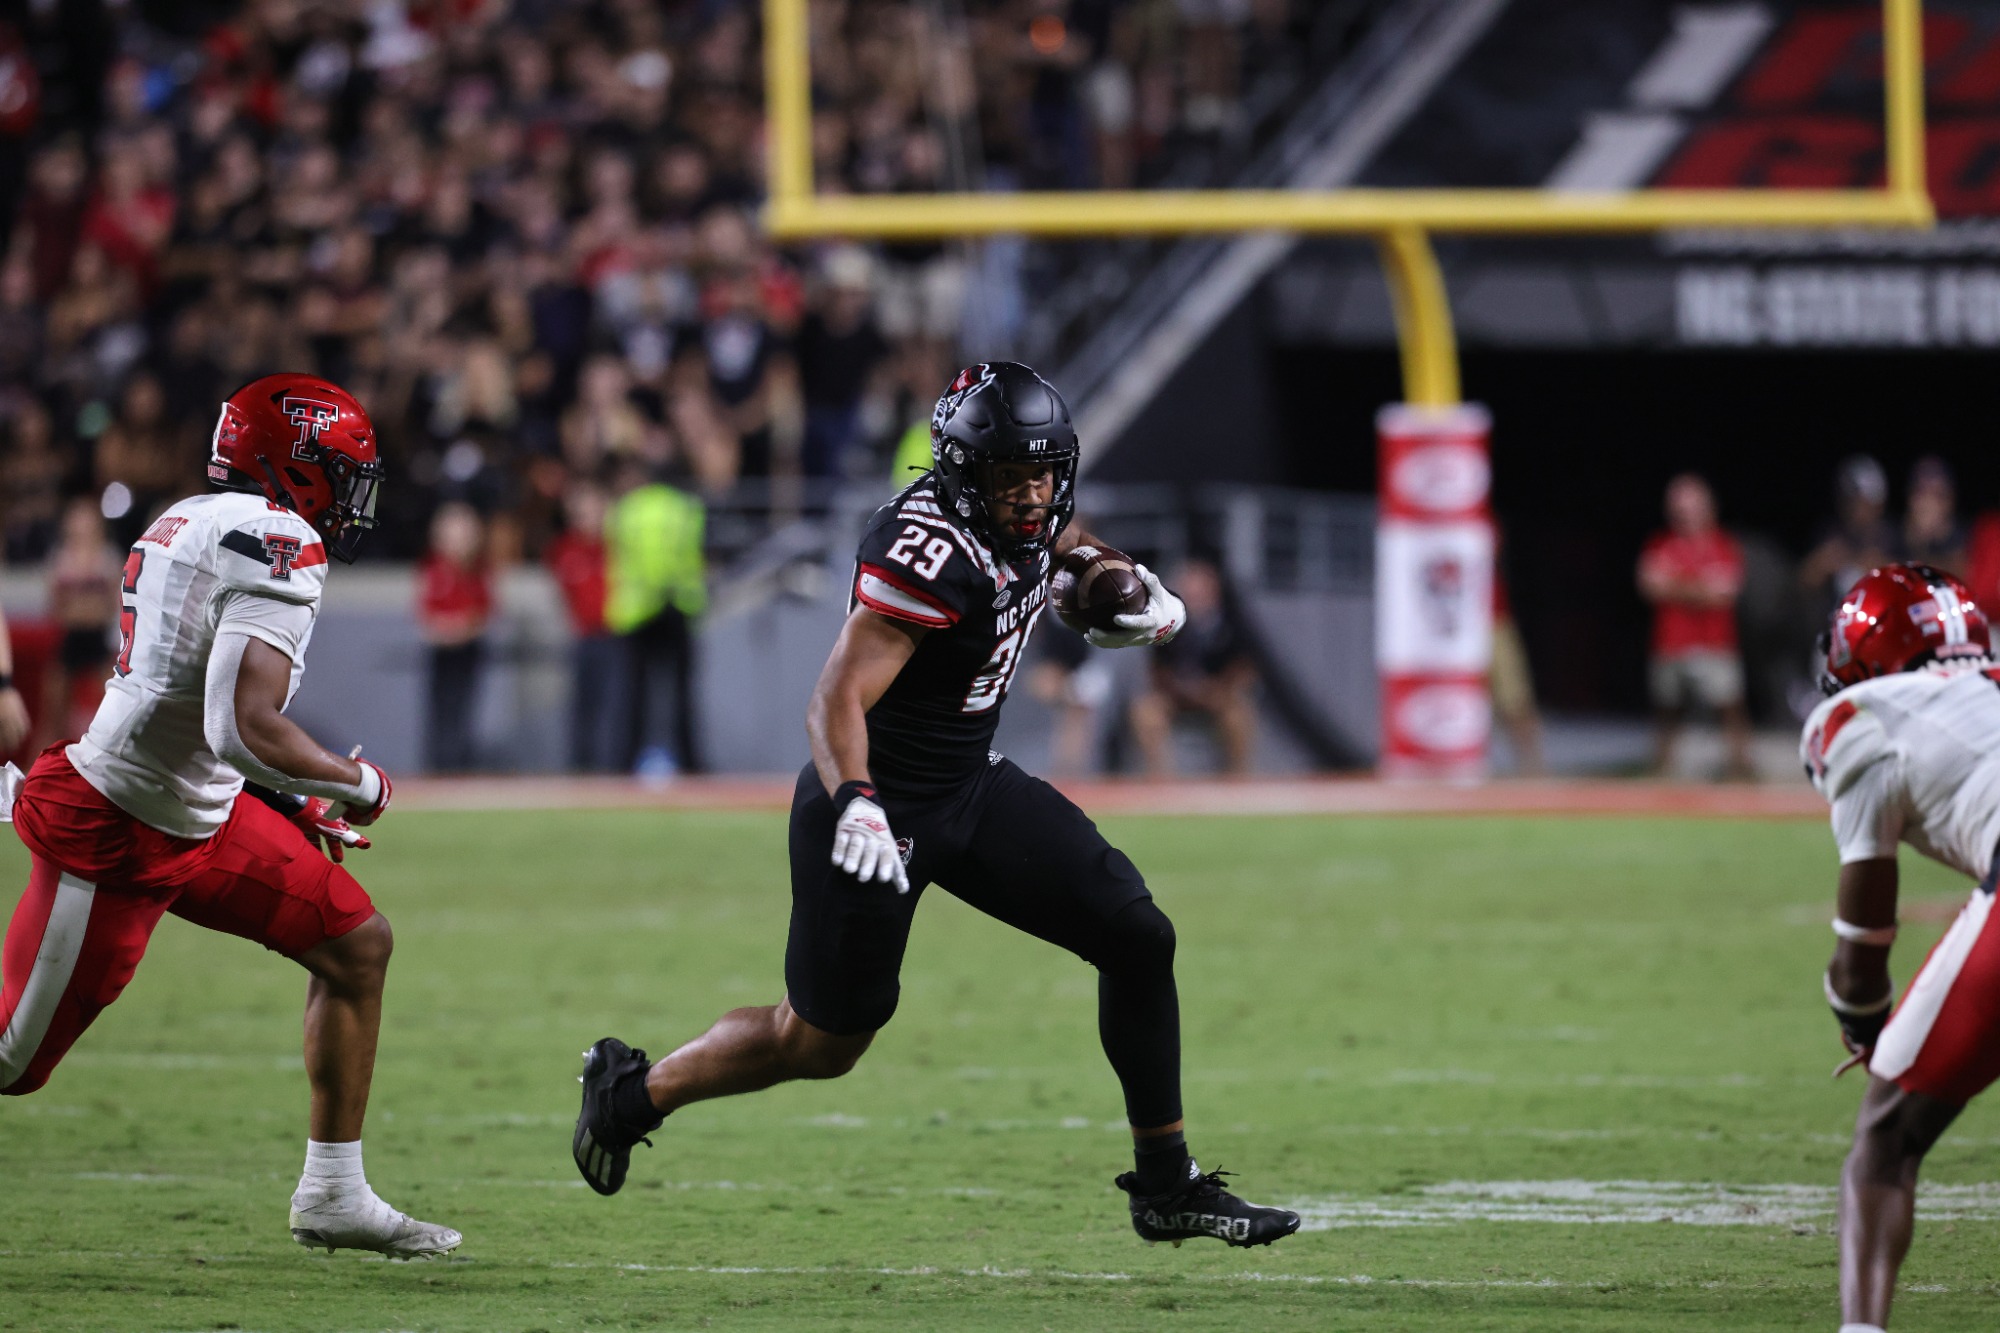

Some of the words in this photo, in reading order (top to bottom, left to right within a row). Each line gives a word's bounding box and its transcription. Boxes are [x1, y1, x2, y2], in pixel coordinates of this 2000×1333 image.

[1029, 439, 1048, 452] HTT
[885, 524, 954, 582] 29
[996, 606, 1018, 637] NC
[1020, 574, 1048, 620] STAT
